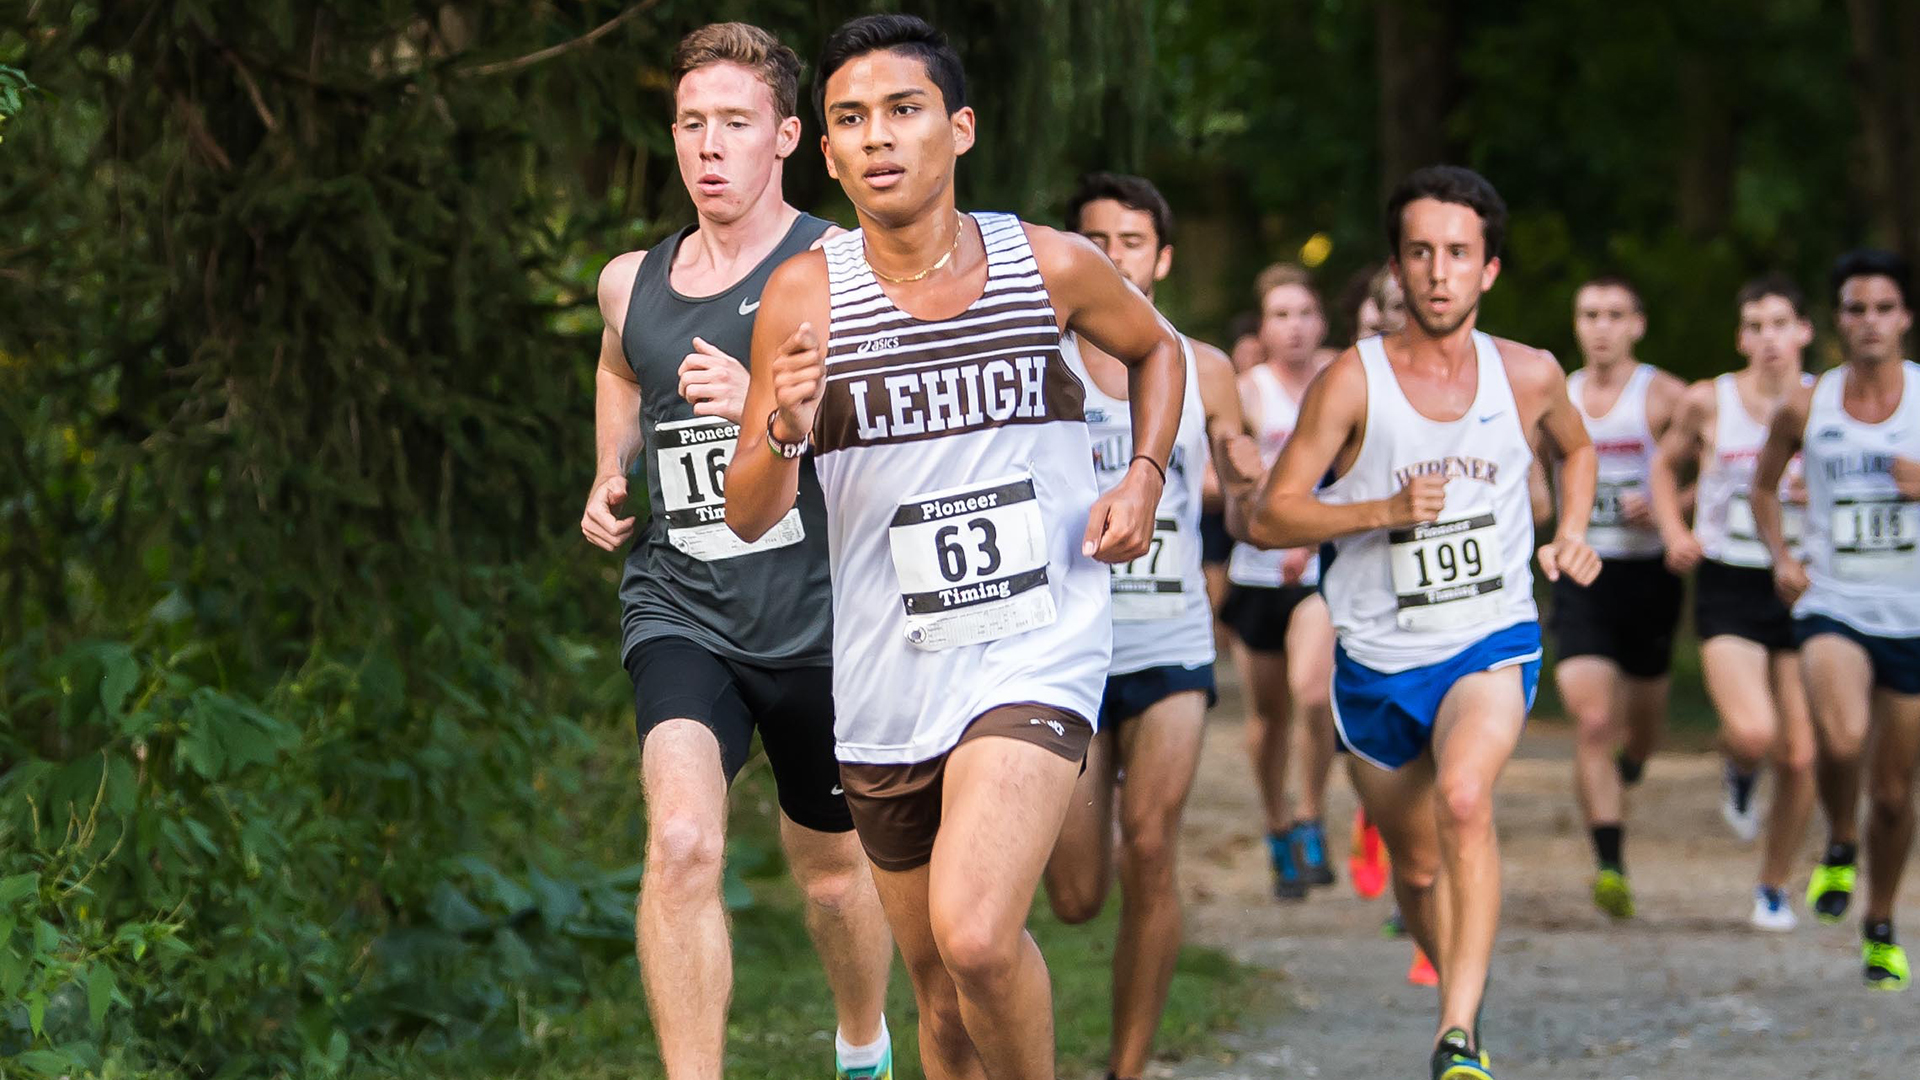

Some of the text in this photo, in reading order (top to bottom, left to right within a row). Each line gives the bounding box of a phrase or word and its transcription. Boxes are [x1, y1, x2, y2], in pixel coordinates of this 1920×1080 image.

[871, 336, 900, 352] asics
[849, 356, 1047, 440] LEHIGH
[679, 425, 741, 445] Pioneer
[920, 492, 998, 521] Pioneer
[934, 517, 1002, 583] 63
[1413, 538, 1483, 588] 199
[938, 579, 1012, 607] Timing
